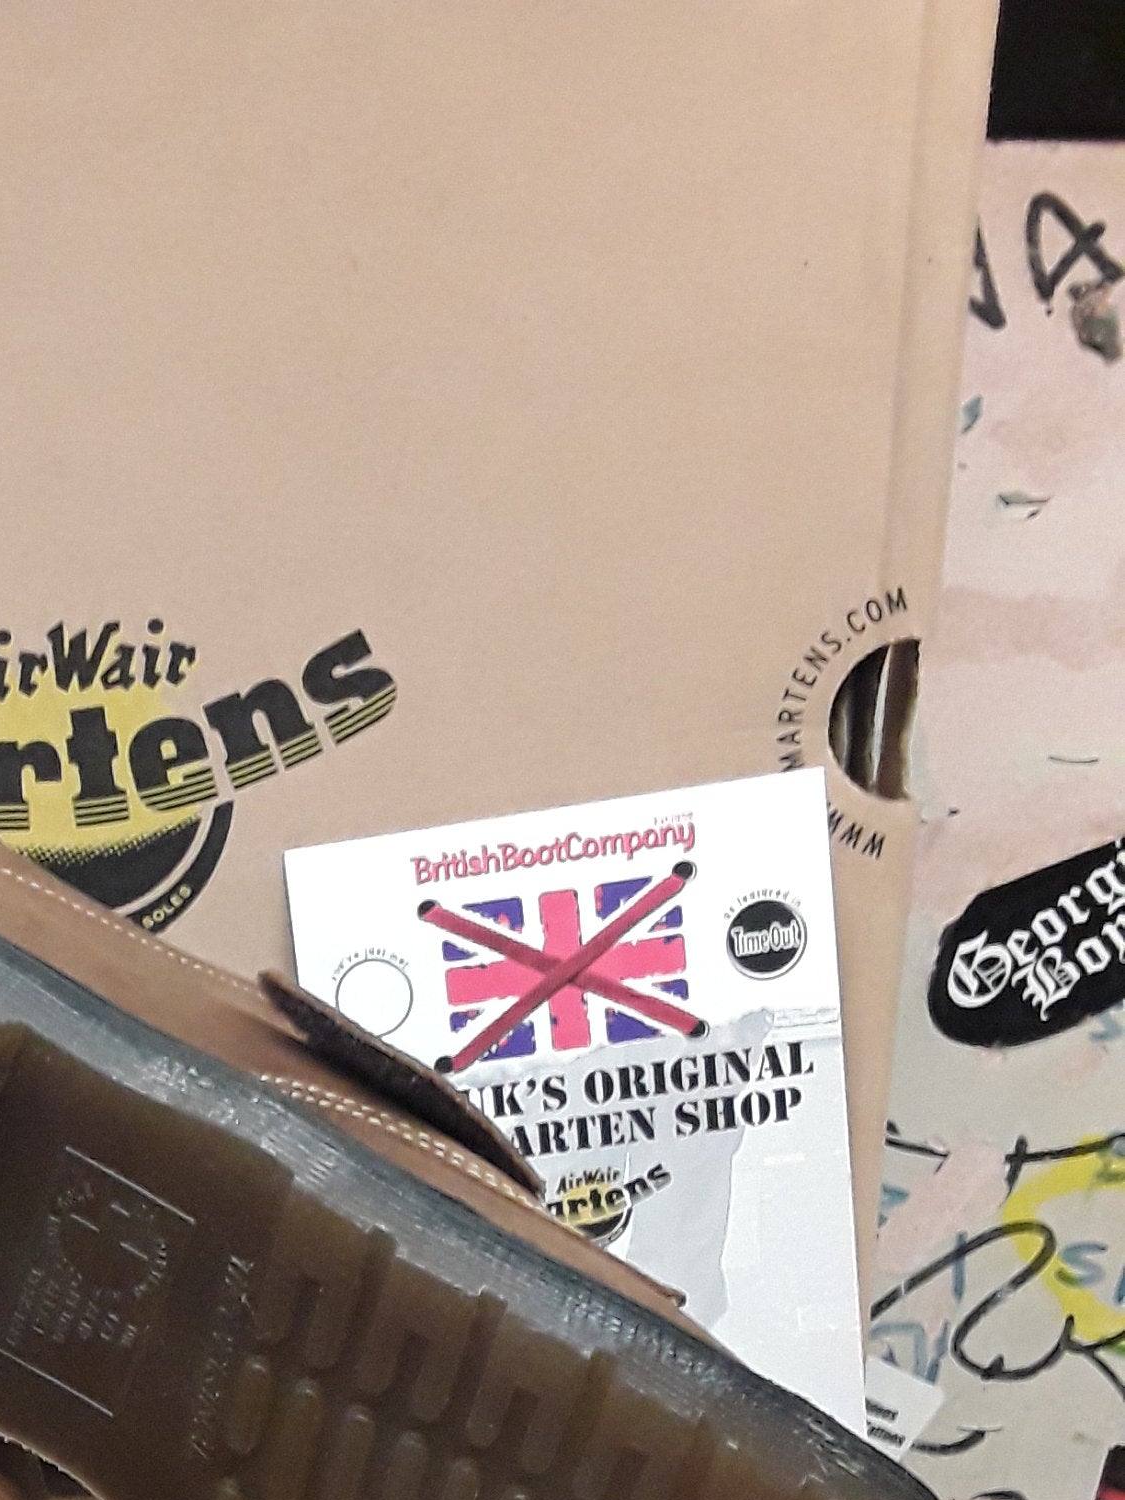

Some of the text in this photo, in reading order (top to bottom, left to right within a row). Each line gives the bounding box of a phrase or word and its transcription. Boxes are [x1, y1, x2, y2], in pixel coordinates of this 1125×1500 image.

[411, 822, 695, 883] BritishBootCompany
[584, 1040, 815, 1106] ORIGINAL
[511, 1086, 803, 1158] ARTEN SHOP
[546, 1162, 673, 1222] artens
